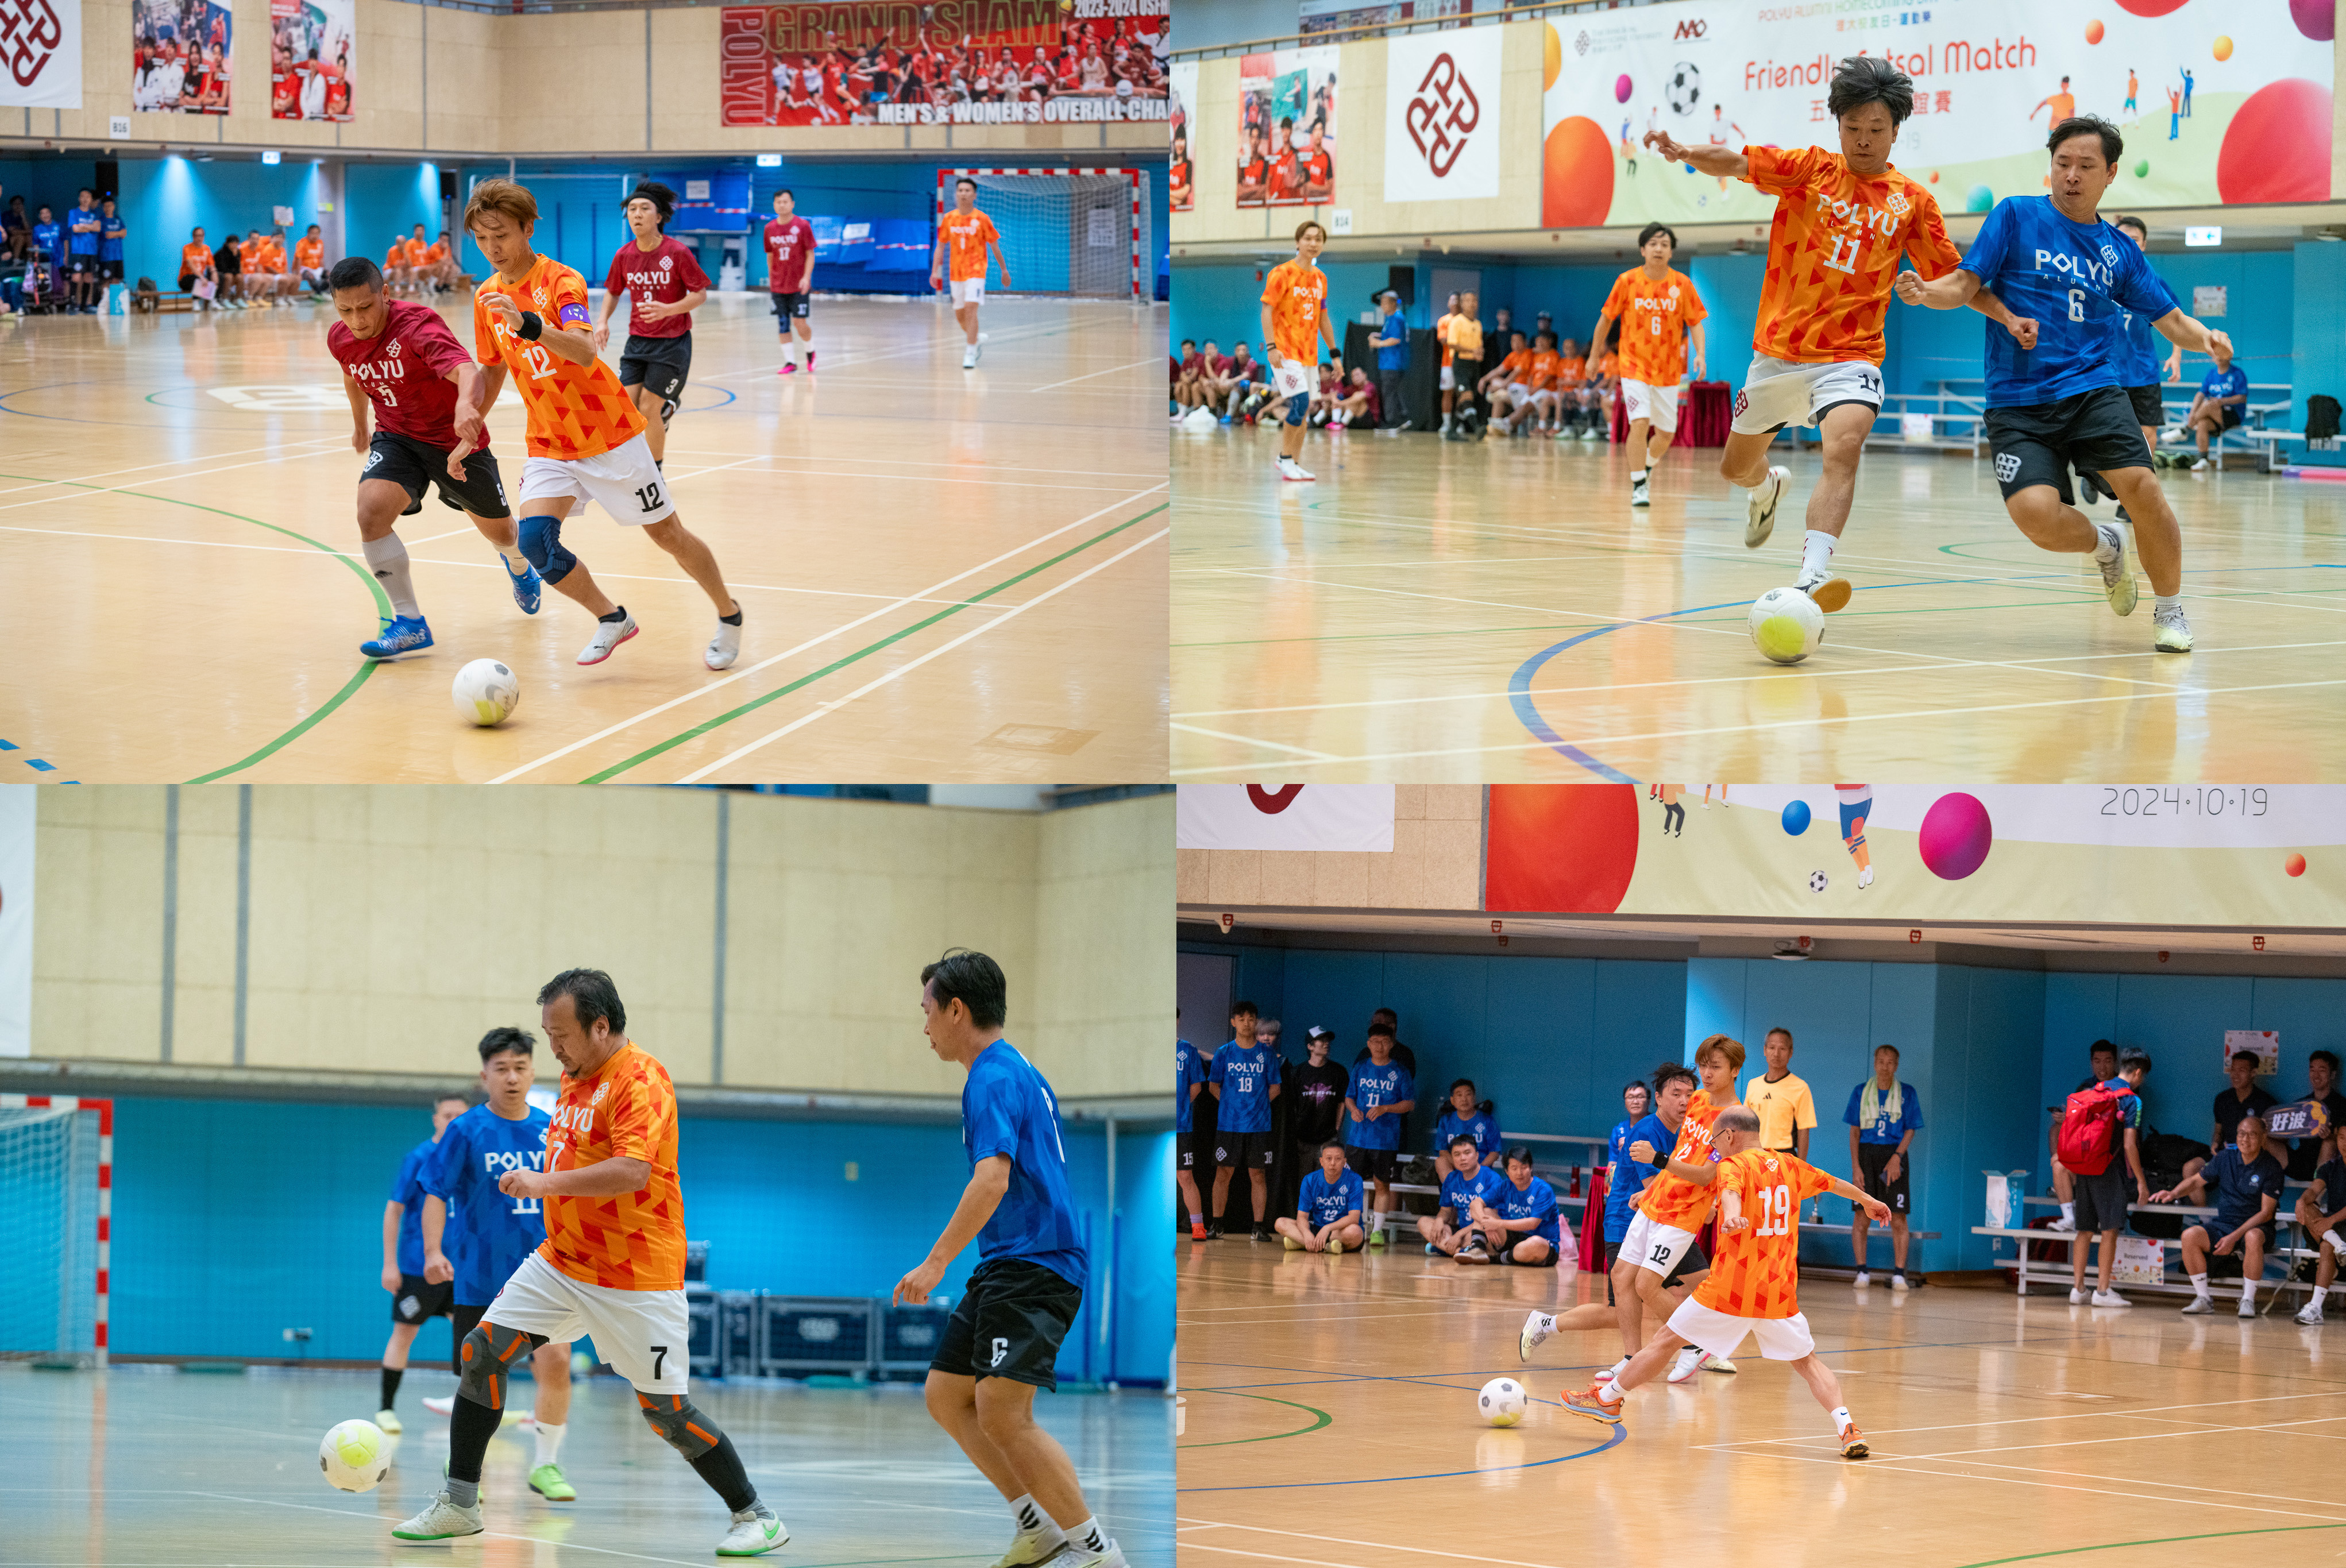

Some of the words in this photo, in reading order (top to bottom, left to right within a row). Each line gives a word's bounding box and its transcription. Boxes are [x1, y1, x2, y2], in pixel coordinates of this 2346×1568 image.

[1074, 0, 1137, 17] 2023-2024
[766, 4, 920, 53] GRAND
[931, 0, 1060, 49] SLAM
[723, 9, 766, 126] POLYU
[878, 103, 932, 123] MEN'S
[936, 106, 950, 123] &
[952, 102, 1039, 123] WOMEN'S
[1044, 100, 1124, 122] OVERALL
[1816, 193, 1899, 236] POLYU
[1820, 217, 1885, 244] ALUMNI
[1823, 234, 1861, 275] 11
[627, 271, 670, 284] POLYU
[2035, 249, 2113, 287] POLYU
[2043, 274, 2108, 295] ALUMNI
[1634, 298, 1677, 312] POLYU
[2069, 288, 2086, 322] 6
[1651, 316, 1661, 336] 6
[2123, 314, 2133, 331] 7
[348, 359, 404, 381] POLYU
[521, 345, 558, 381] 12
[375, 384, 398, 407] 5
[665, 379, 678, 394] 3
[635, 482, 665, 513] 12
[1228, 1062, 1264, 1073] POLYU
[1238, 1077, 1253, 1092] 18
[1360, 1078, 1395, 1091] POLYU
[553, 1104, 595, 1133] OLYU
[1877, 1120, 1886, 1137] 2
[2270, 1110, 2307, 1132] 好波
[1682, 1116, 1714, 1146] POLYU
[550, 1140, 565, 1173] 7
[1183, 1152, 1194, 1166] 15
[1674, 1142, 1692, 1161] 12
[1316, 1195, 1346, 1206] POLYU
[1756, 1184, 1791, 1237] 19
[1896, 1193, 1905, 1208] 2
[1649, 1243, 1671, 1266] 12
[650, 1346, 668, 1381] 7
